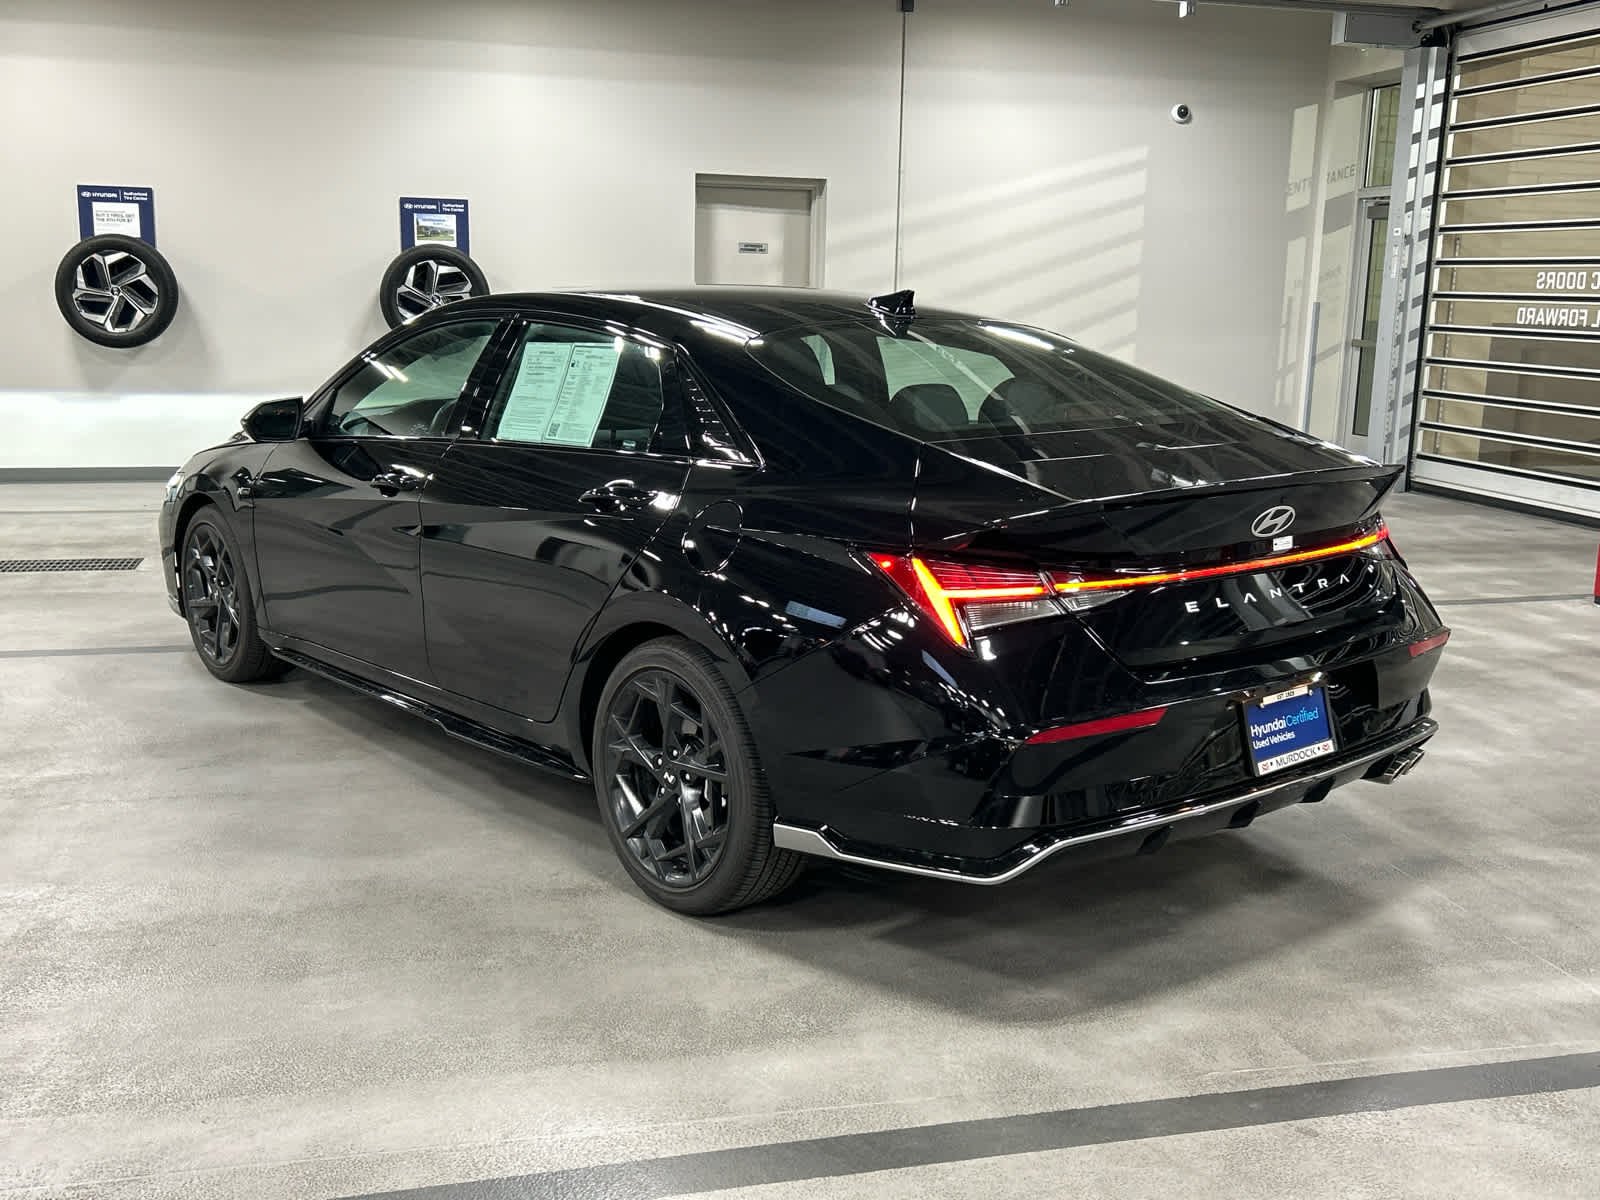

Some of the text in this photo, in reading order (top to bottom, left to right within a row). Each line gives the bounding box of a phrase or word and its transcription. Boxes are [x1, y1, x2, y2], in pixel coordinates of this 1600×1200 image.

[1185, 573, 1350, 613] ELANTRA
[1252, 730, 1296, 750] Used Vehicles
[1275, 747, 1317, 768] MURDOCK
